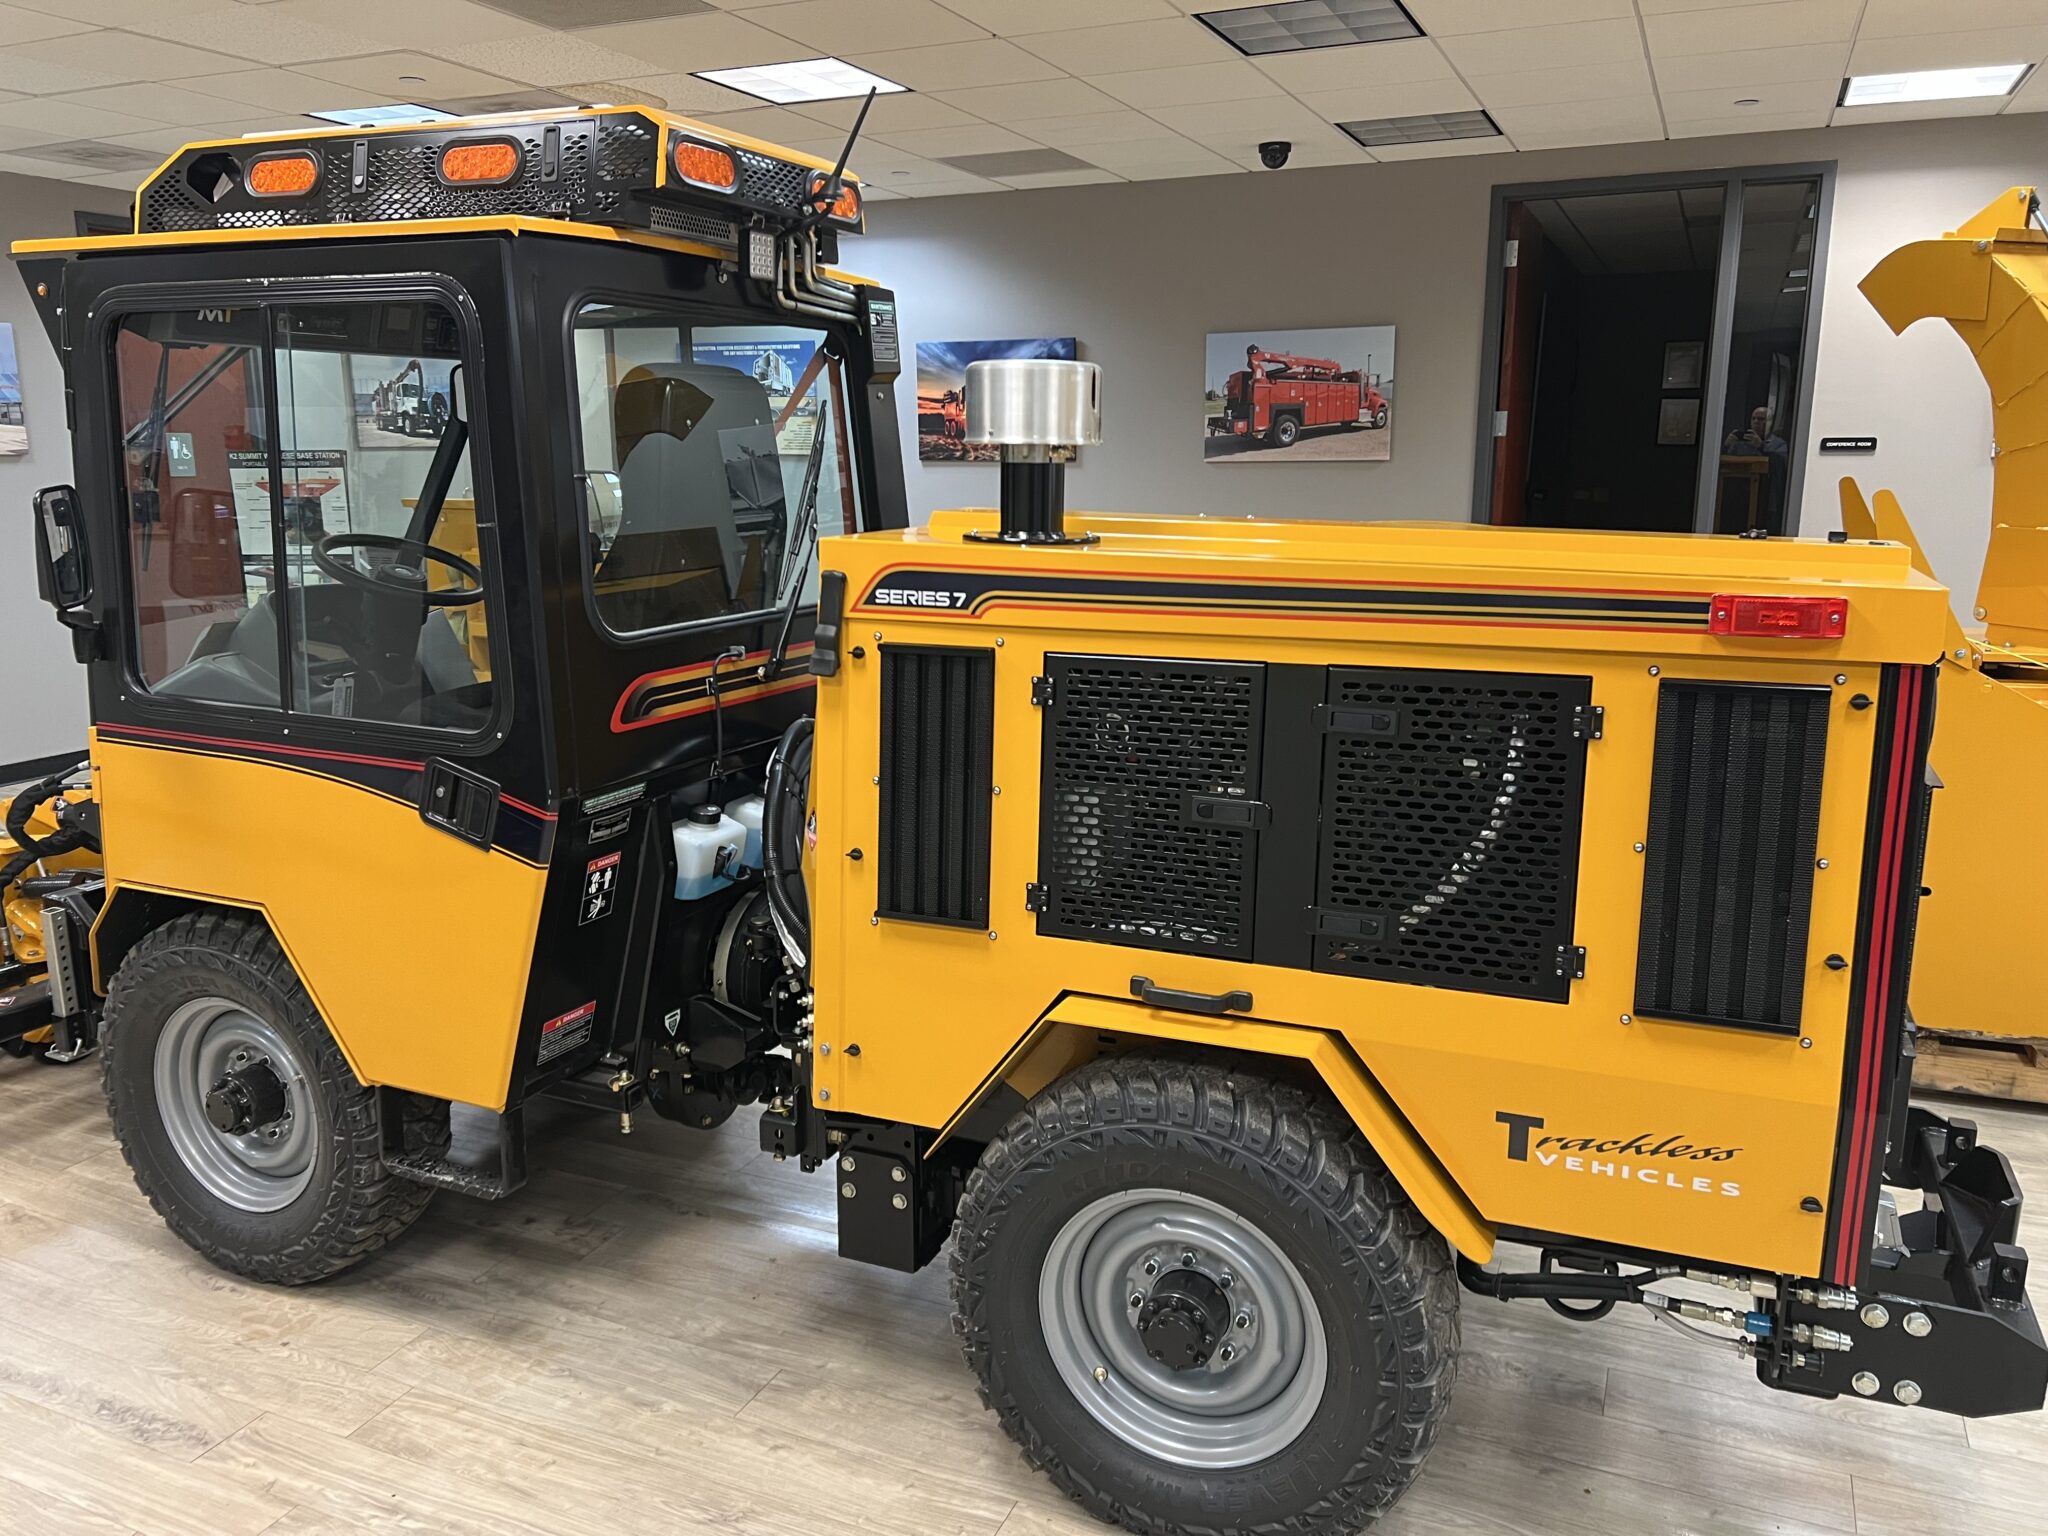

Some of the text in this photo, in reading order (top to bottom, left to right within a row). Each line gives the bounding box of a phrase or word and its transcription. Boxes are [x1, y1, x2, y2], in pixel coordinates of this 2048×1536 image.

[297, 452, 313, 460] BASE
[875, 588, 967, 608] SERIES 7
[597, 855, 619, 868] DANGER
[562, 1008, 585, 1024] DANGER
[1495, 1111, 1744, 1162] Trackless
[1535, 1151, 1741, 1197] VEHICLES
